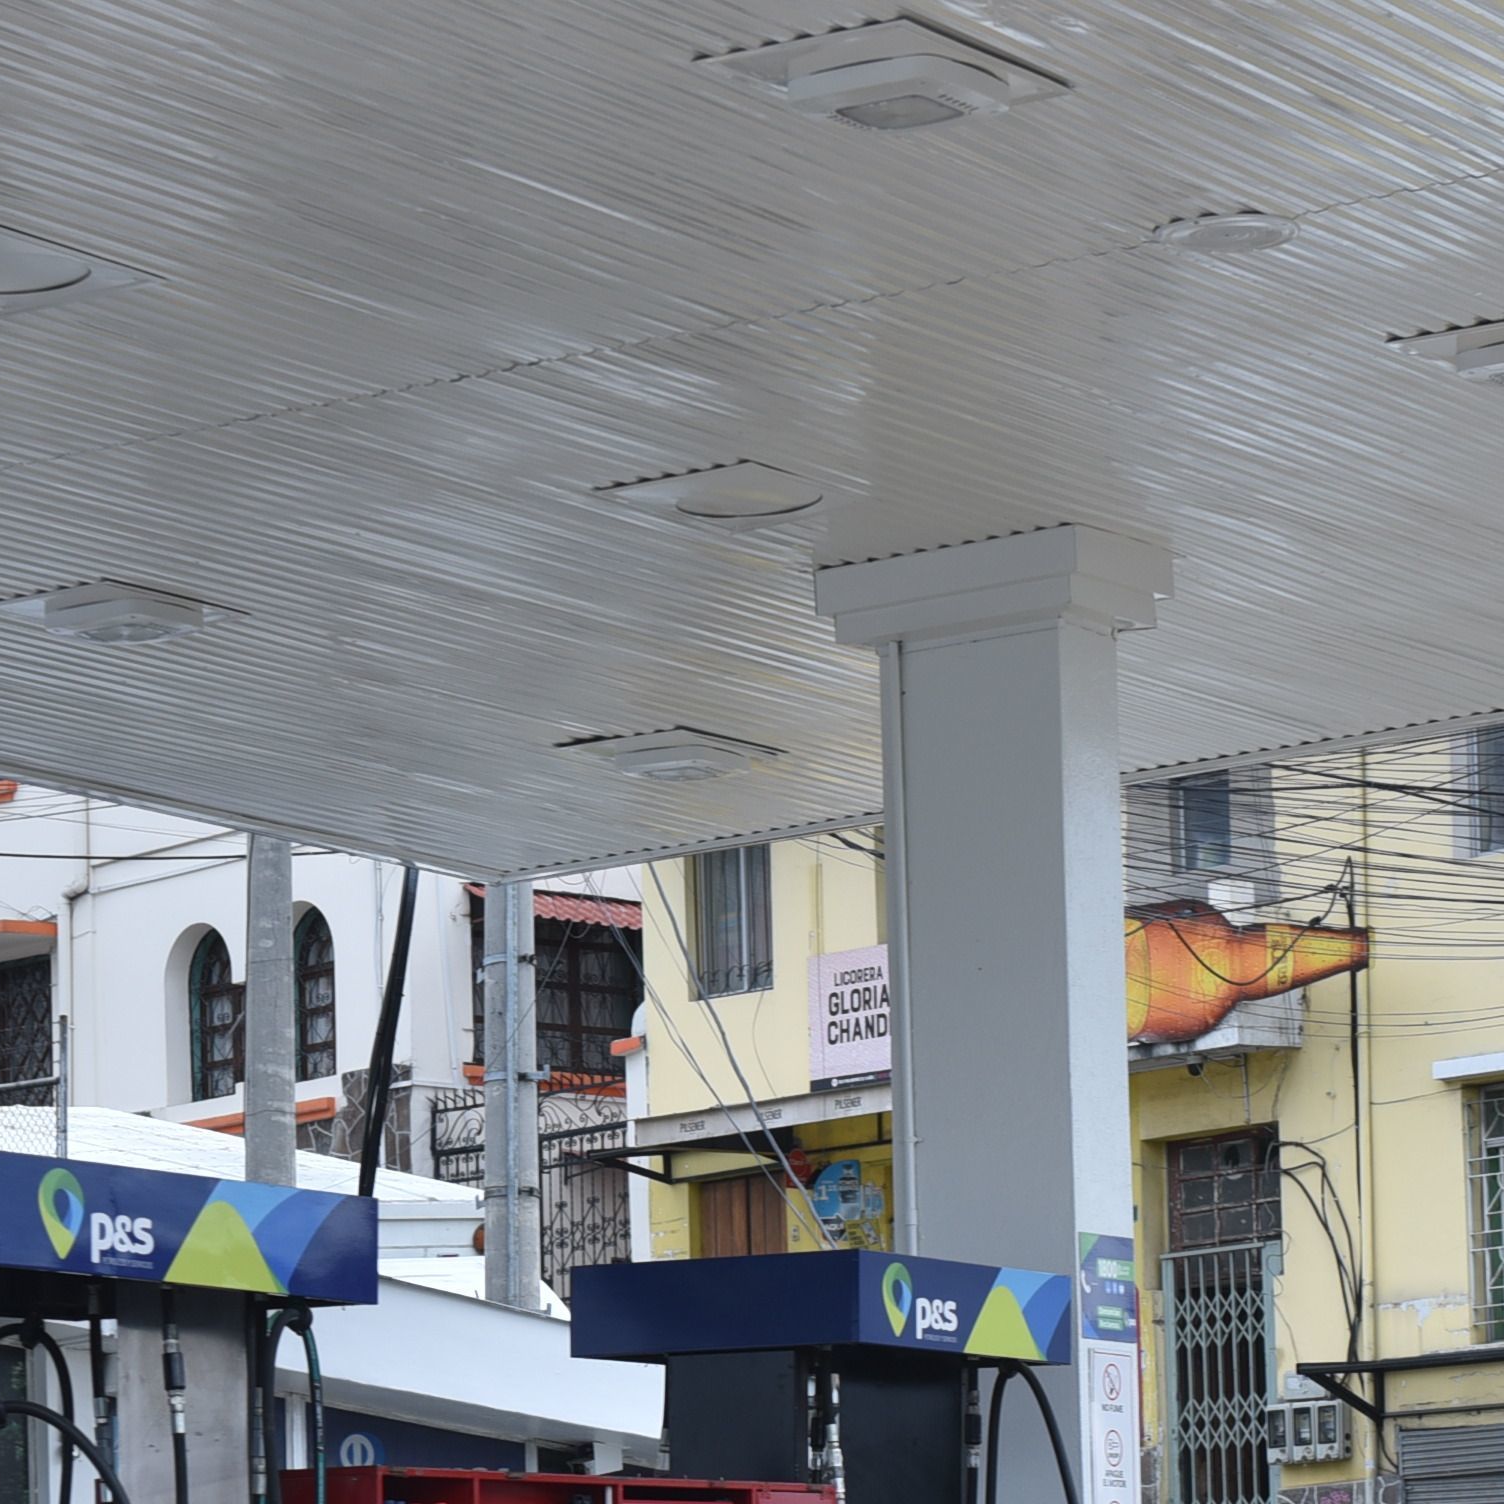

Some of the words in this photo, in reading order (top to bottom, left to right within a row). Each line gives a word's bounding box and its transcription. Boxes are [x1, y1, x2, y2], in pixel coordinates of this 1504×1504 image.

[834, 965, 884, 987] LICORERA
[828, 983, 891, 1017] GLORIA
[827, 1012, 891, 1046] CHAND
[834, 1096, 862, 1110] PILSENER
[679, 1119, 705, 1133] PILSENER
[90, 1211, 155, 1264] p&s
[915, 1297, 959, 1340] p&s
